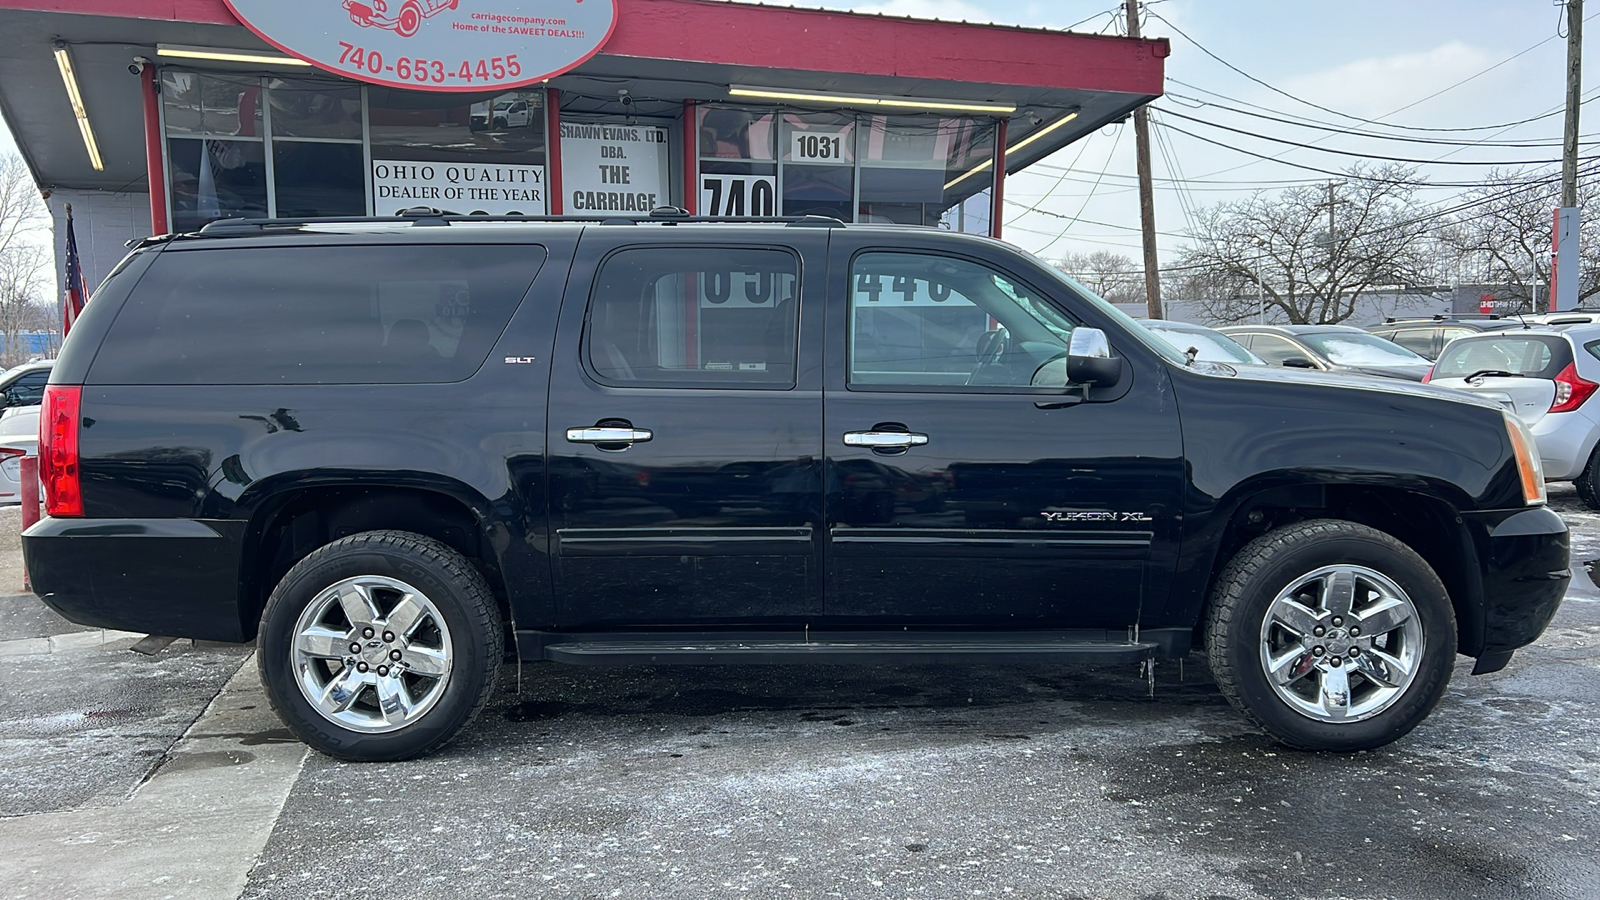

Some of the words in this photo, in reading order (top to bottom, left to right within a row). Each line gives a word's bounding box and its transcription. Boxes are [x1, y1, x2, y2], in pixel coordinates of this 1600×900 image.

[471, 12, 566, 26] carriagecompany.com
[452, 22, 479, 31] Home
[480, 24, 490, 32] of
[492, 25, 506, 34] the
[508, 26, 545, 36] SAWEET
[547, 29, 585, 39] DEALS!!!
[338, 41, 521, 83] 740-653-4455
[560, 125, 601, 140] SHAWN
[645, 130, 666, 144] LTD.
[600, 145, 627, 159] DBA.
[797, 135, 840, 158] 1031
[375, 165, 435, 180] OHIO
[446, 167, 542, 184] QUALITY
[599, 165, 630, 184] THE
[378, 186, 440, 199] DEALER
[444, 187, 464, 200] OF
[468, 188, 498, 200] THE
[502, 189, 541, 201] YEAR
[573, 190, 656, 212] CARRIAGE
[704, 178, 773, 216] 740
[504, 356, 536, 364] SLT
[1041, 512, 1118, 521] YUKON
[1121, 512, 1153, 521] XL
